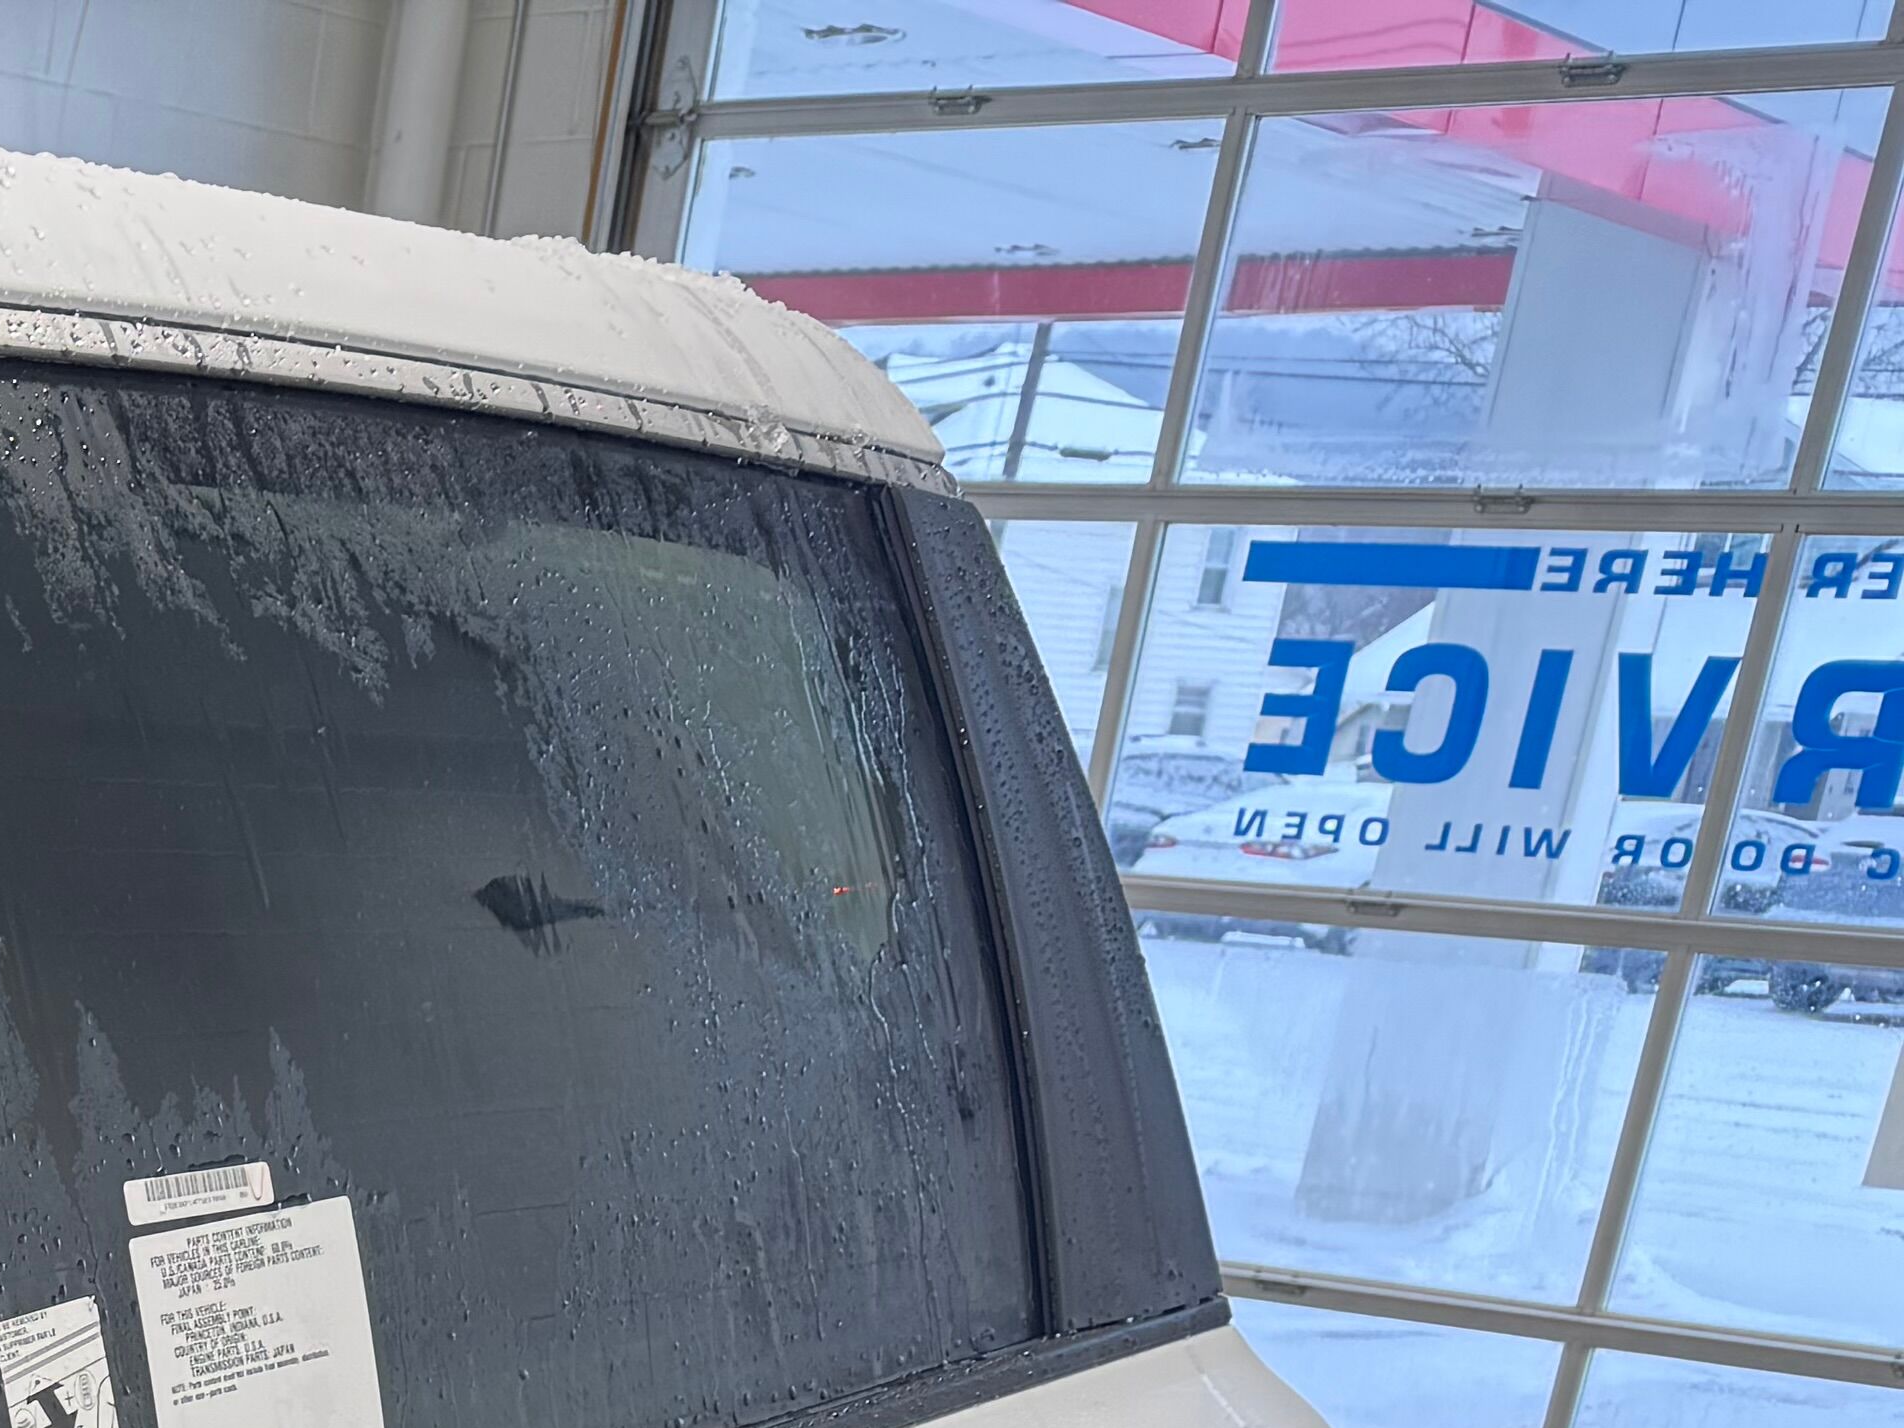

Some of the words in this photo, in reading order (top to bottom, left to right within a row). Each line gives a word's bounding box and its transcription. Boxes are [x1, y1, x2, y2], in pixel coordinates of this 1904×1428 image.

[186, 1233, 210, 1248] PARTS
[211, 1226, 244, 1243] CONTENT
[244, 1216, 292, 1236] INFORMATION
[149, 1254, 165, 1268] FOR
[166, 1247, 200, 1265] VEHICLES
[201, 1245, 210, 1257] IN
[212, 1241, 228, 1255] THIS
[208, 1252, 233, 1268] PARTS
[161, 1273, 189, 1290] MAJOR
[189, 1266, 223, 1284] SOURCES
[224, 1264, 233, 1276] OF
[235, 1256, 266, 1274] FOREIGN
[266, 1251, 289, 1267] PARTS
[176, 1282, 202, 1298] JAPAN
[159, 1311, 175, 1325] FOR
[176, 1307, 193, 1321] THIS
[194, 1299, 227, 1317] VEHICLE:
[169, 1320, 192, 1335] FINAL
[192, 1311, 231, 1330] ASSEMBLY
[172, 1339, 208, 1359] COUNTRY
[209, 1337, 219, 1349] OF
[188, 1350, 214, 1366] ENGINE
[190, 1354, 245, 1378] TRANSMISSION
[271, 1342, 295, 1358] JAPAN
